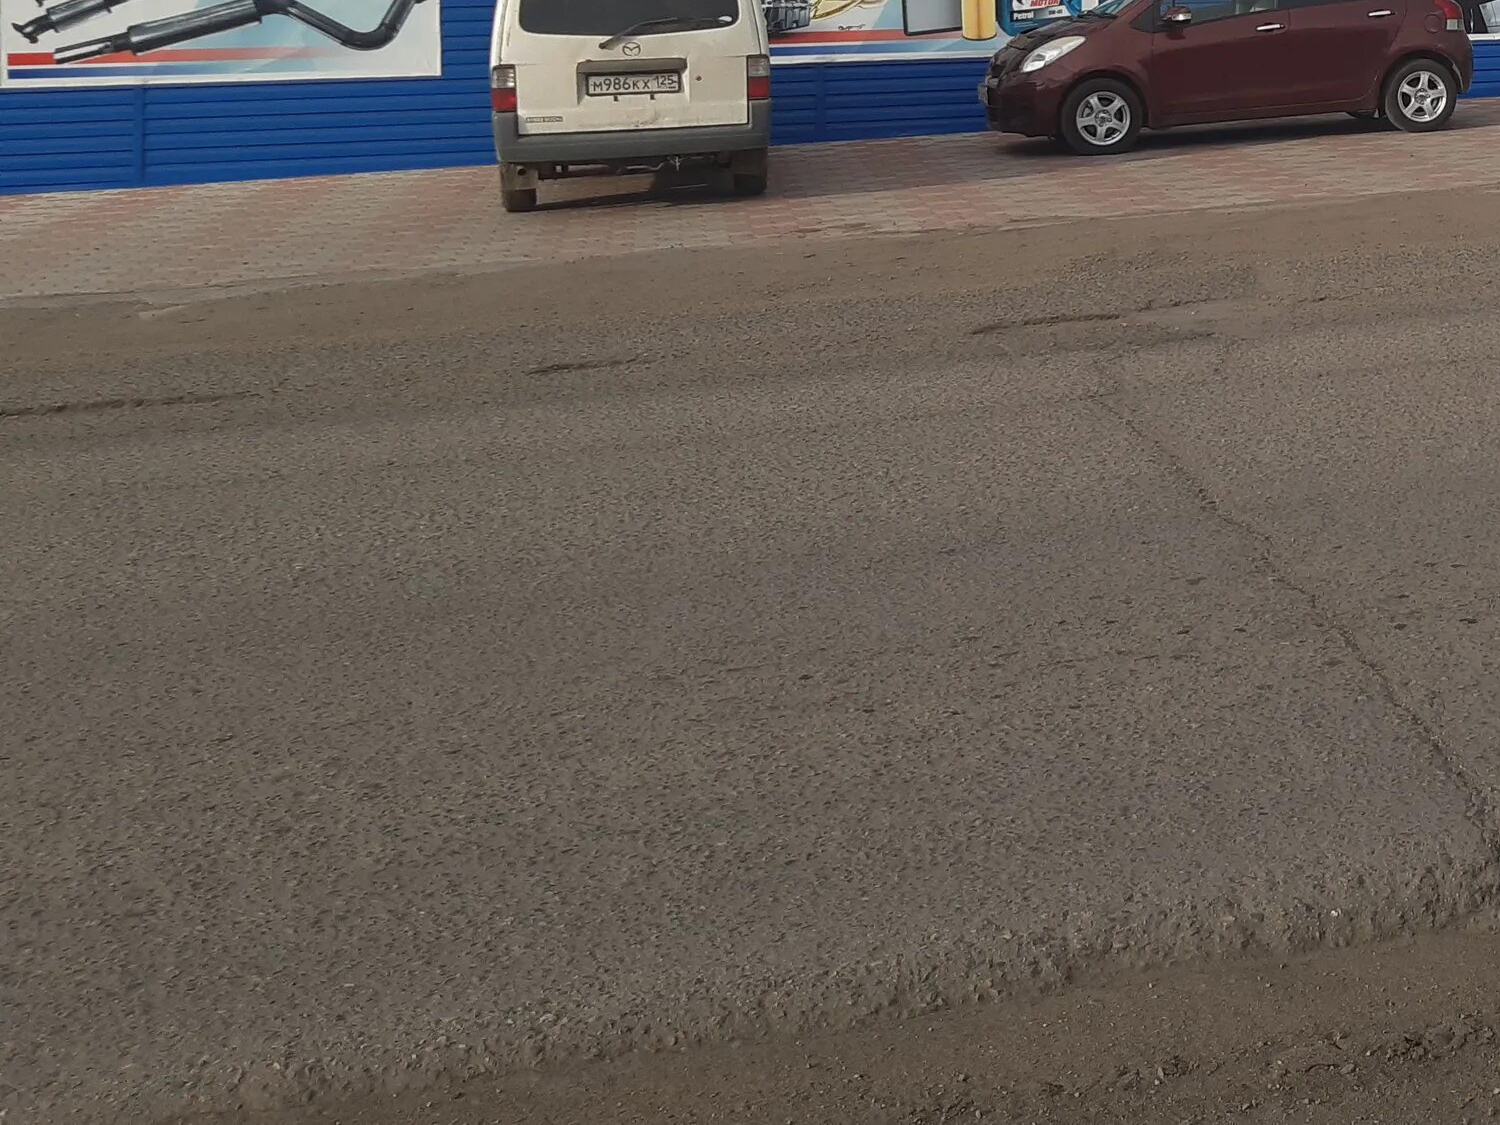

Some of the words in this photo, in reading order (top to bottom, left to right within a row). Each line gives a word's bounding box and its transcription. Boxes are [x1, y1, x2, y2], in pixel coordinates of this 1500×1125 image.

[1013, 11, 1034, 20] Petrol
[593, 77, 650, 91] М986КХ
[653, 75, 674, 88] 125
